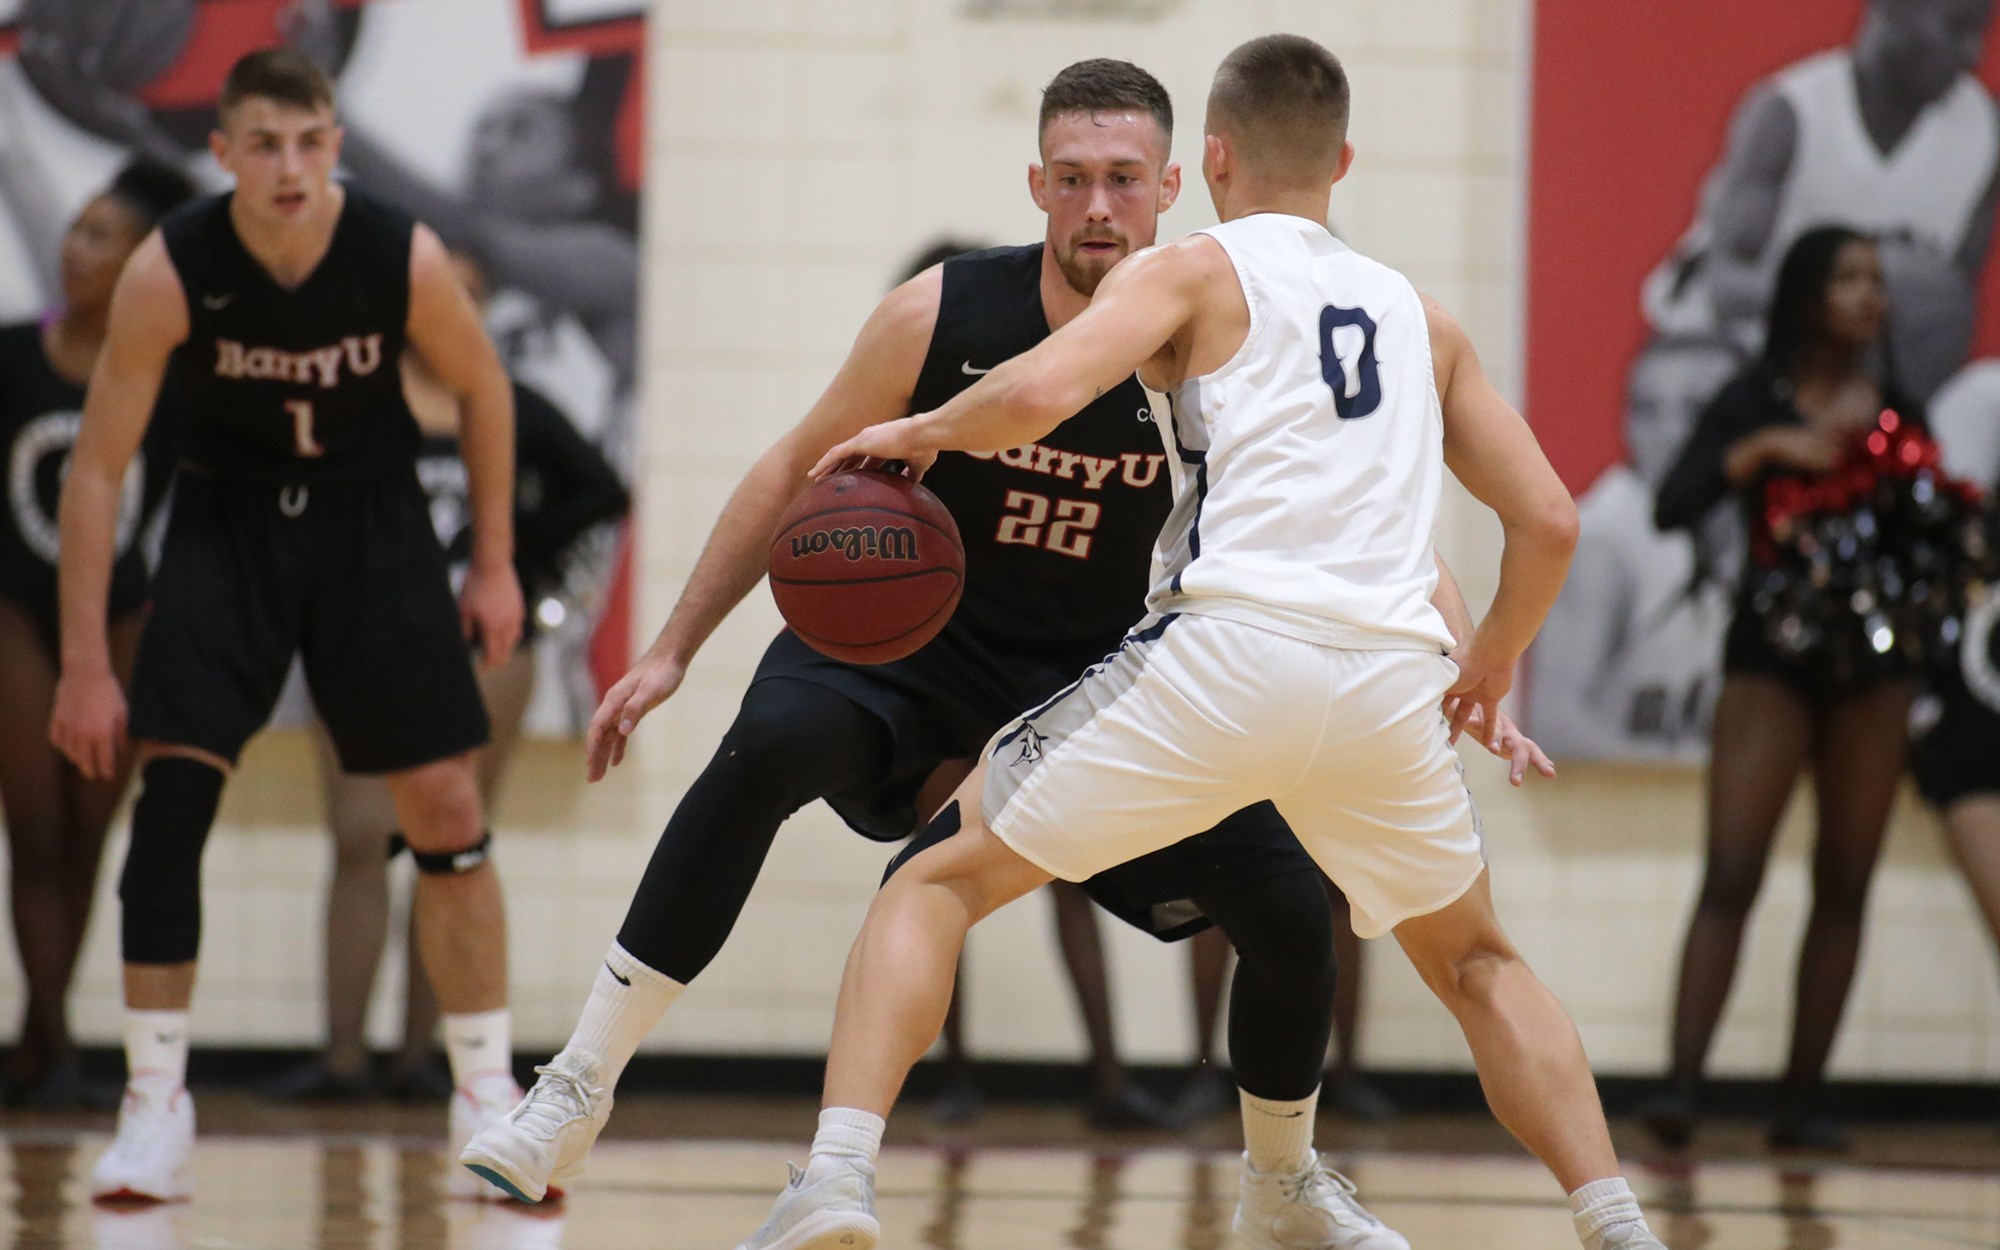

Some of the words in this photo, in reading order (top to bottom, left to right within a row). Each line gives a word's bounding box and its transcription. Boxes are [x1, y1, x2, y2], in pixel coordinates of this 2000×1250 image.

[1317, 301, 1384, 420] 0
[284, 399, 325, 458] 1
[963, 443, 1117, 490] arry
[790, 526, 920, 562] Wilson
[993, 488, 1101, 560] 22
